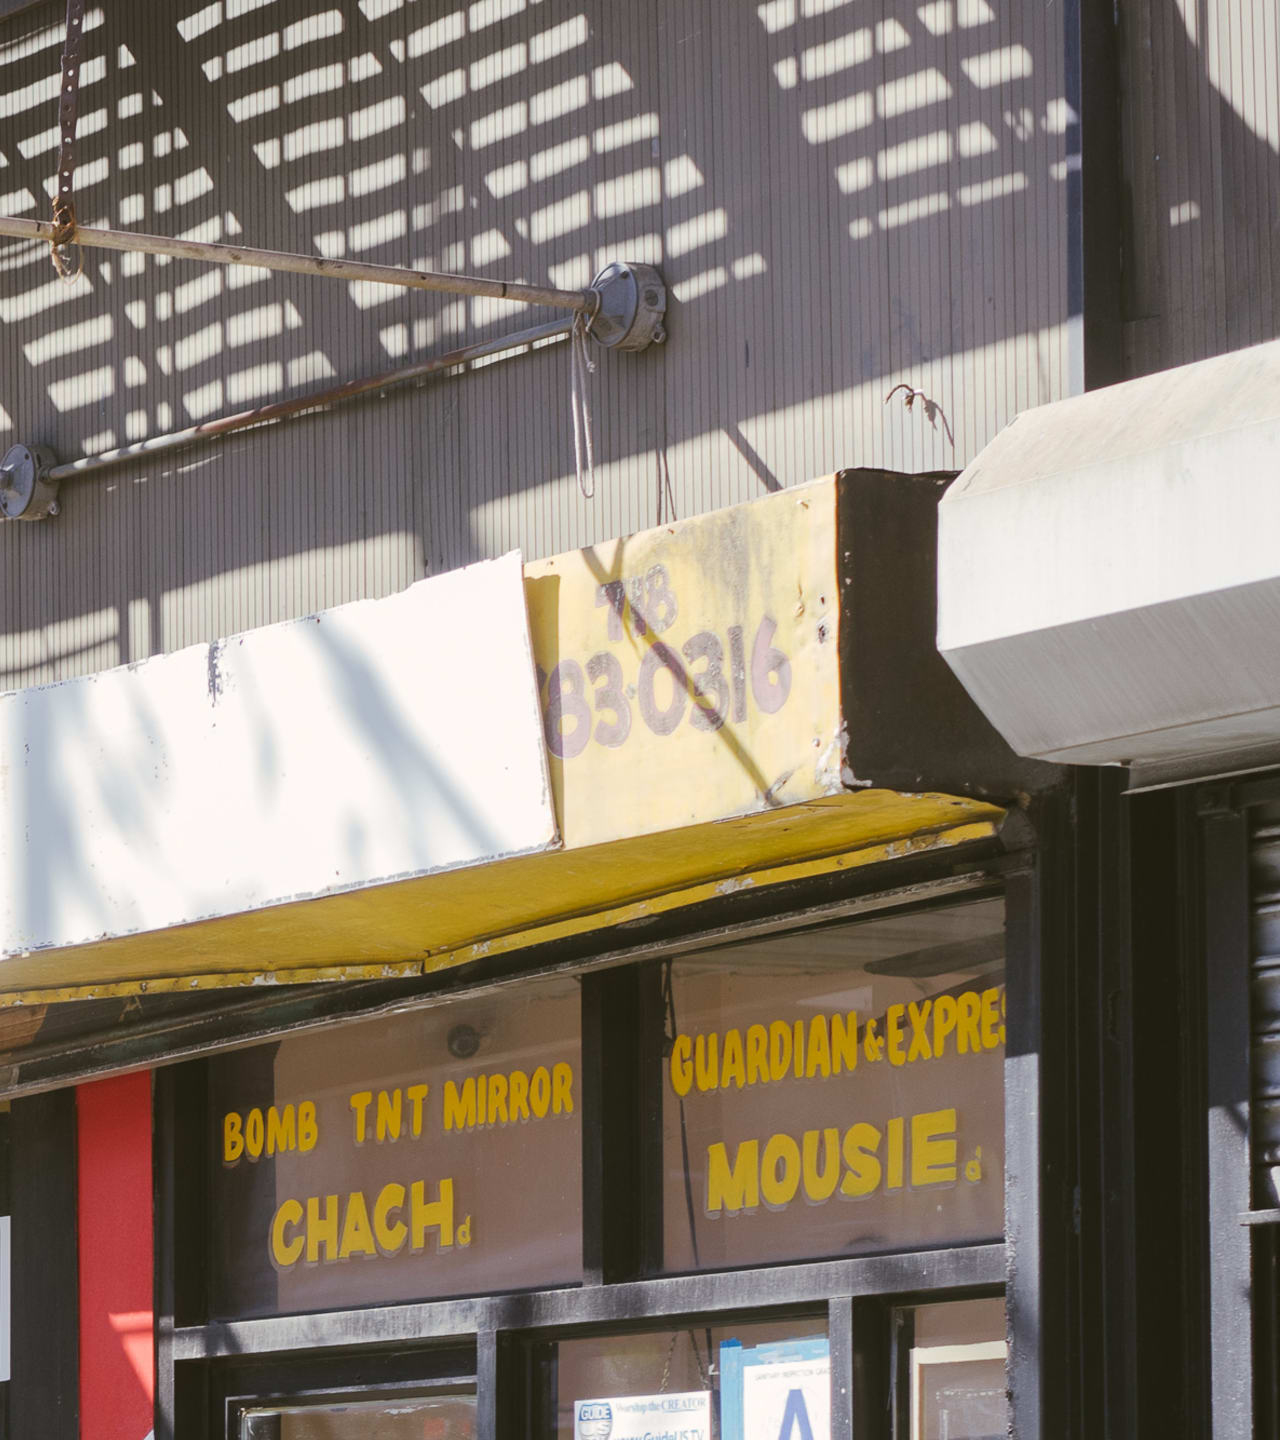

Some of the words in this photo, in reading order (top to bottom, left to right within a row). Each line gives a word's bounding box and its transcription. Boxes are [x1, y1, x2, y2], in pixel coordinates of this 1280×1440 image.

[595, 564, 677, 641] 718
[671, 1011, 858, 1096] GUARDIAN
[864, 1018, 884, 1063] &
[224, 1101, 318, 1163] BOMB
[444, 1062, 573, 1131] MIRROR
[707, 1108, 957, 1212] MOUSIE
[272, 1178, 454, 1267] CHACH
[580, 1403, 612, 1420] GUIDE
[661, 1397, 706, 1411] CREATOR
